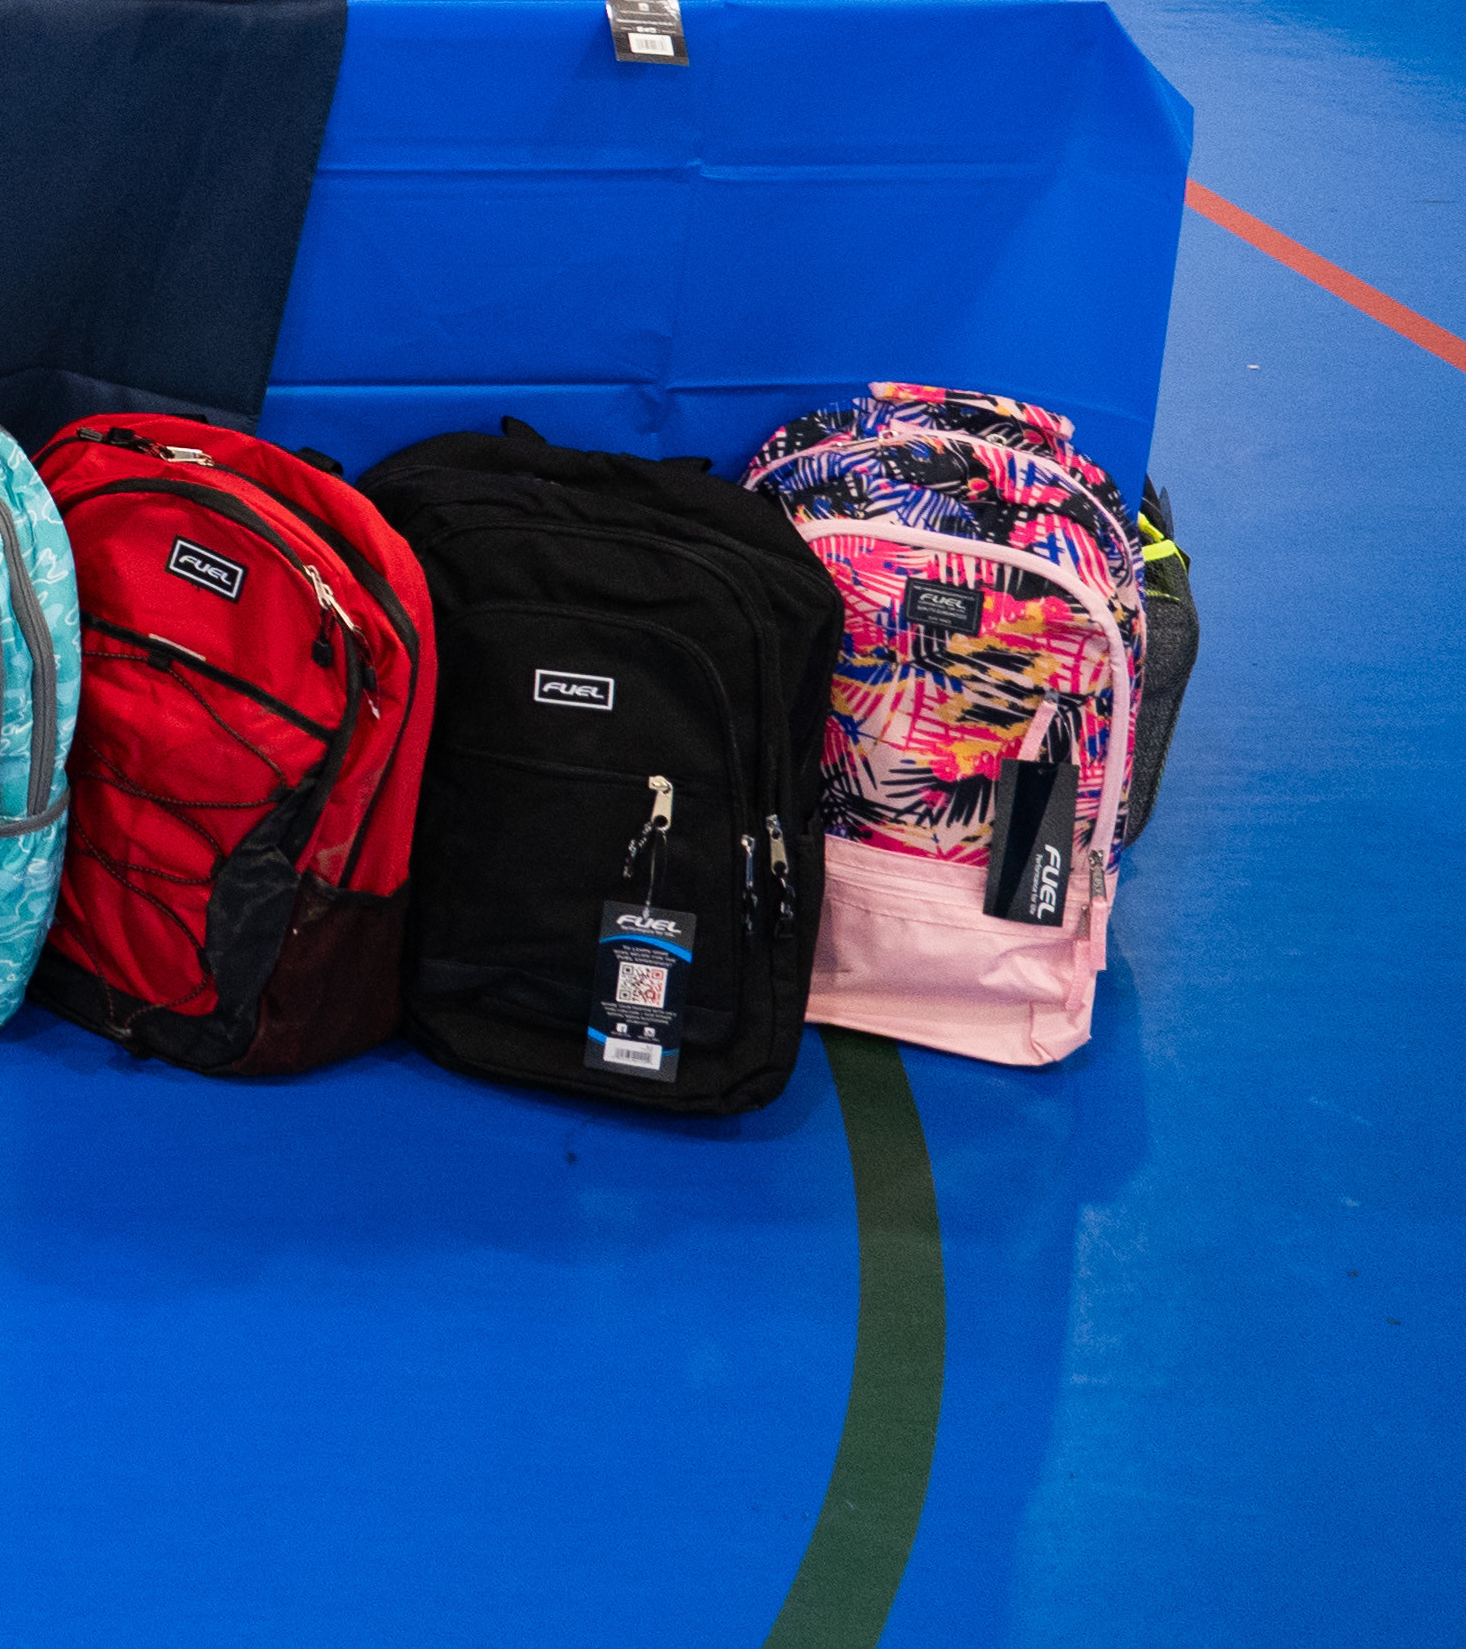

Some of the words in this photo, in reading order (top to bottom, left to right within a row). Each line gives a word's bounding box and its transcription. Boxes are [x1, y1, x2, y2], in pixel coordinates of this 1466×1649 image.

[176, 551, 234, 587] FUEL
[541, 681, 604, 700] FUEL
[1036, 843, 1061, 920] FUEL
[616, 914, 681, 934] FUEL
